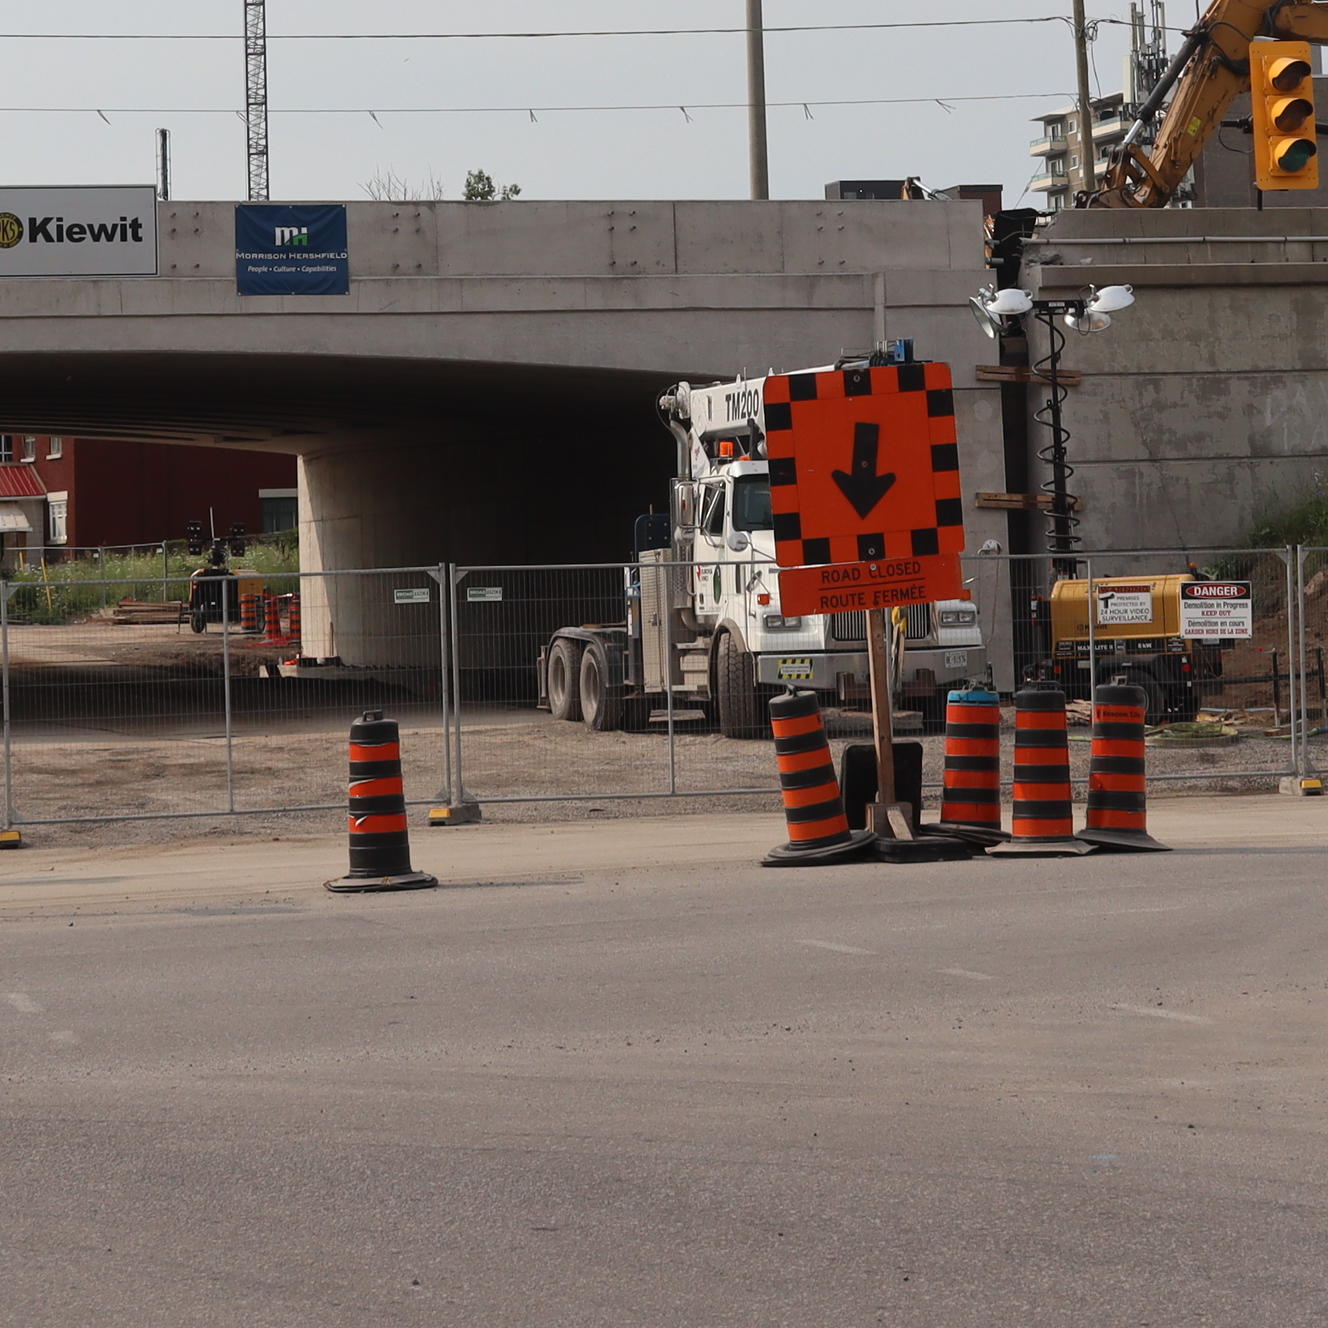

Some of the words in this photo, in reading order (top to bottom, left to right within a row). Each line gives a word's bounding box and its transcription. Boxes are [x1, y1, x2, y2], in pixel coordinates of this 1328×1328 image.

[28, 216, 143, 243] Kiewit
[725, 388, 760, 423] TM200
[821, 566, 861, 584] ROAD
[868, 560, 921, 579] CLOSED
[819, 592, 867, 609] ROUTE
[873, 584, 927, 607] FERMÉE
[1193, 586, 1238, 596] DANGER
[1184, 601, 1215, 610] Demolition
[1223, 601, 1249, 610] Progress
[1102, 614, 1148, 622] SURVEILLANCE
